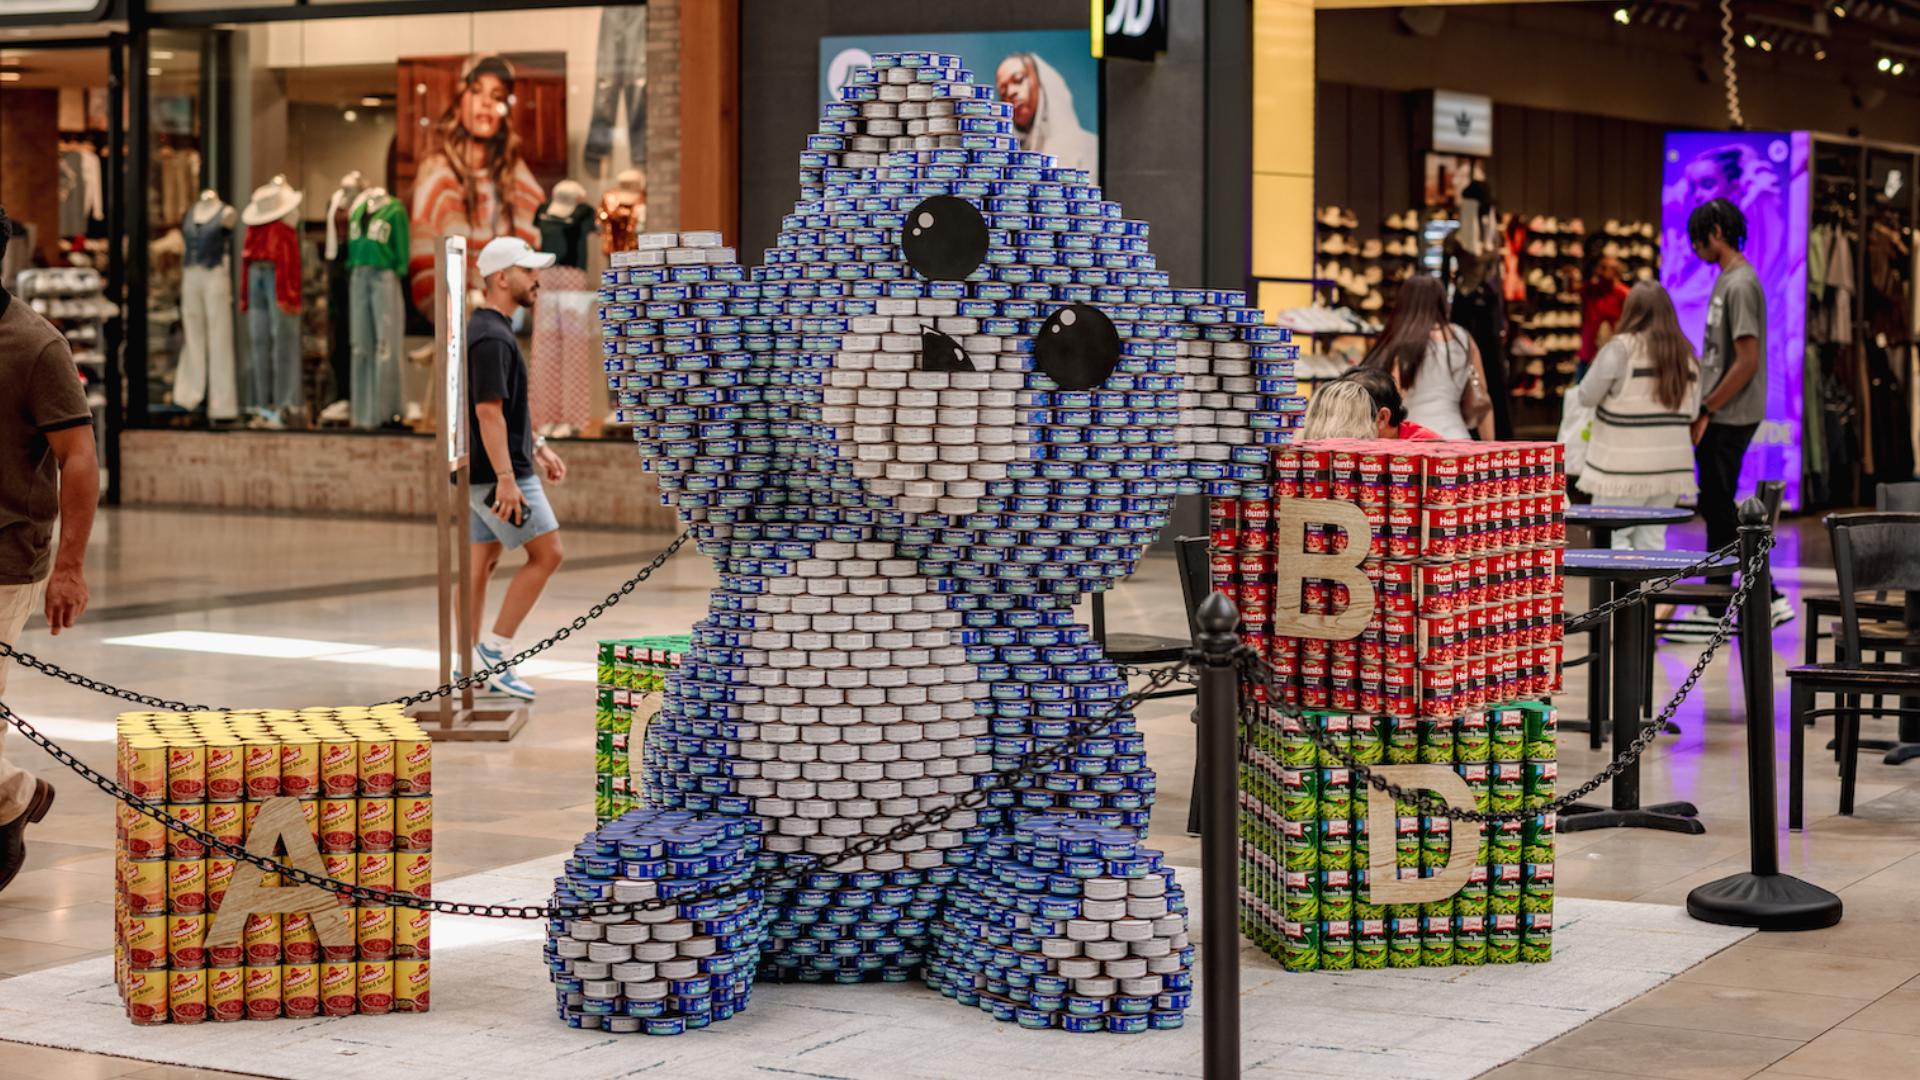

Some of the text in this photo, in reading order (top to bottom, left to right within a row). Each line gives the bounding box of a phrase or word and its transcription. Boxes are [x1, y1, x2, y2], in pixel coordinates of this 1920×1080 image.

[1275, 498, 1375, 640] B
[203, 796, 356, 948] A
[1367, 764, 1479, 904] D
